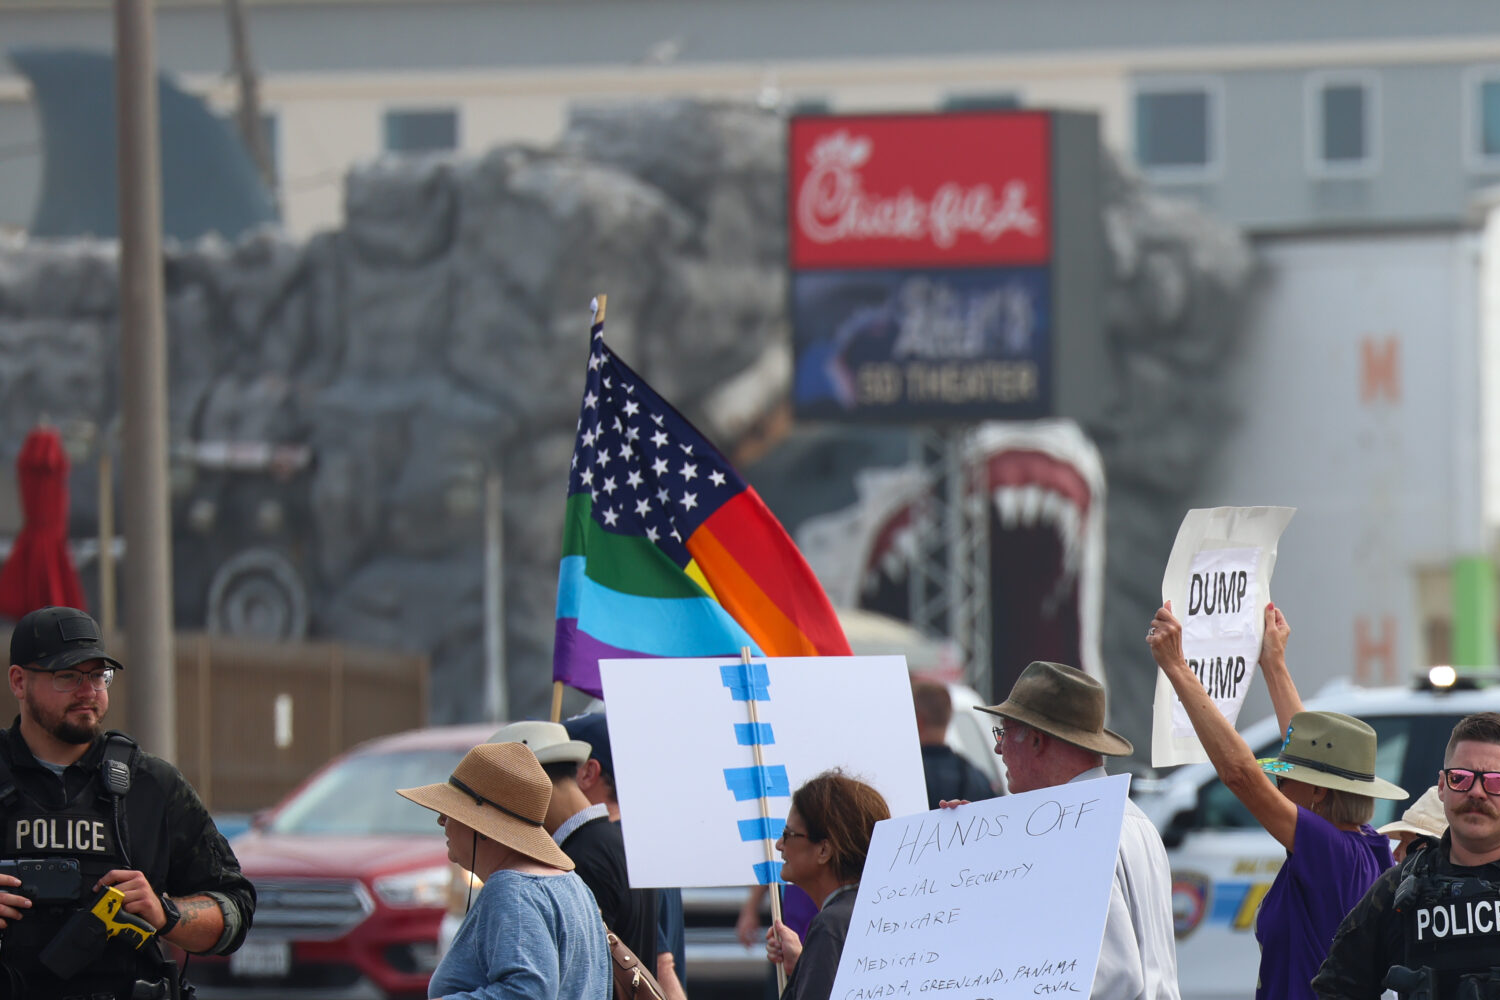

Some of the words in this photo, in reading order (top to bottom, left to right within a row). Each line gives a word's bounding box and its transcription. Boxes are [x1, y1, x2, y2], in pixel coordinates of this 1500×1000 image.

[1188, 570, 1247, 616] DUMP
[1185, 655, 1247, 699] UMP
[16, 818, 105, 851] POLICE
[888, 814, 1009, 872] HANDS
[1025, 798, 1101, 837] OFF
[871, 877, 938, 905] SOCIAL
[950, 862, 1034, 889] SECURITY
[866, 908, 960, 936] MEDICARE
[919, 967, 1009, 993] GREENLAND,
[1013, 958, 1078, 981] PANAMA
